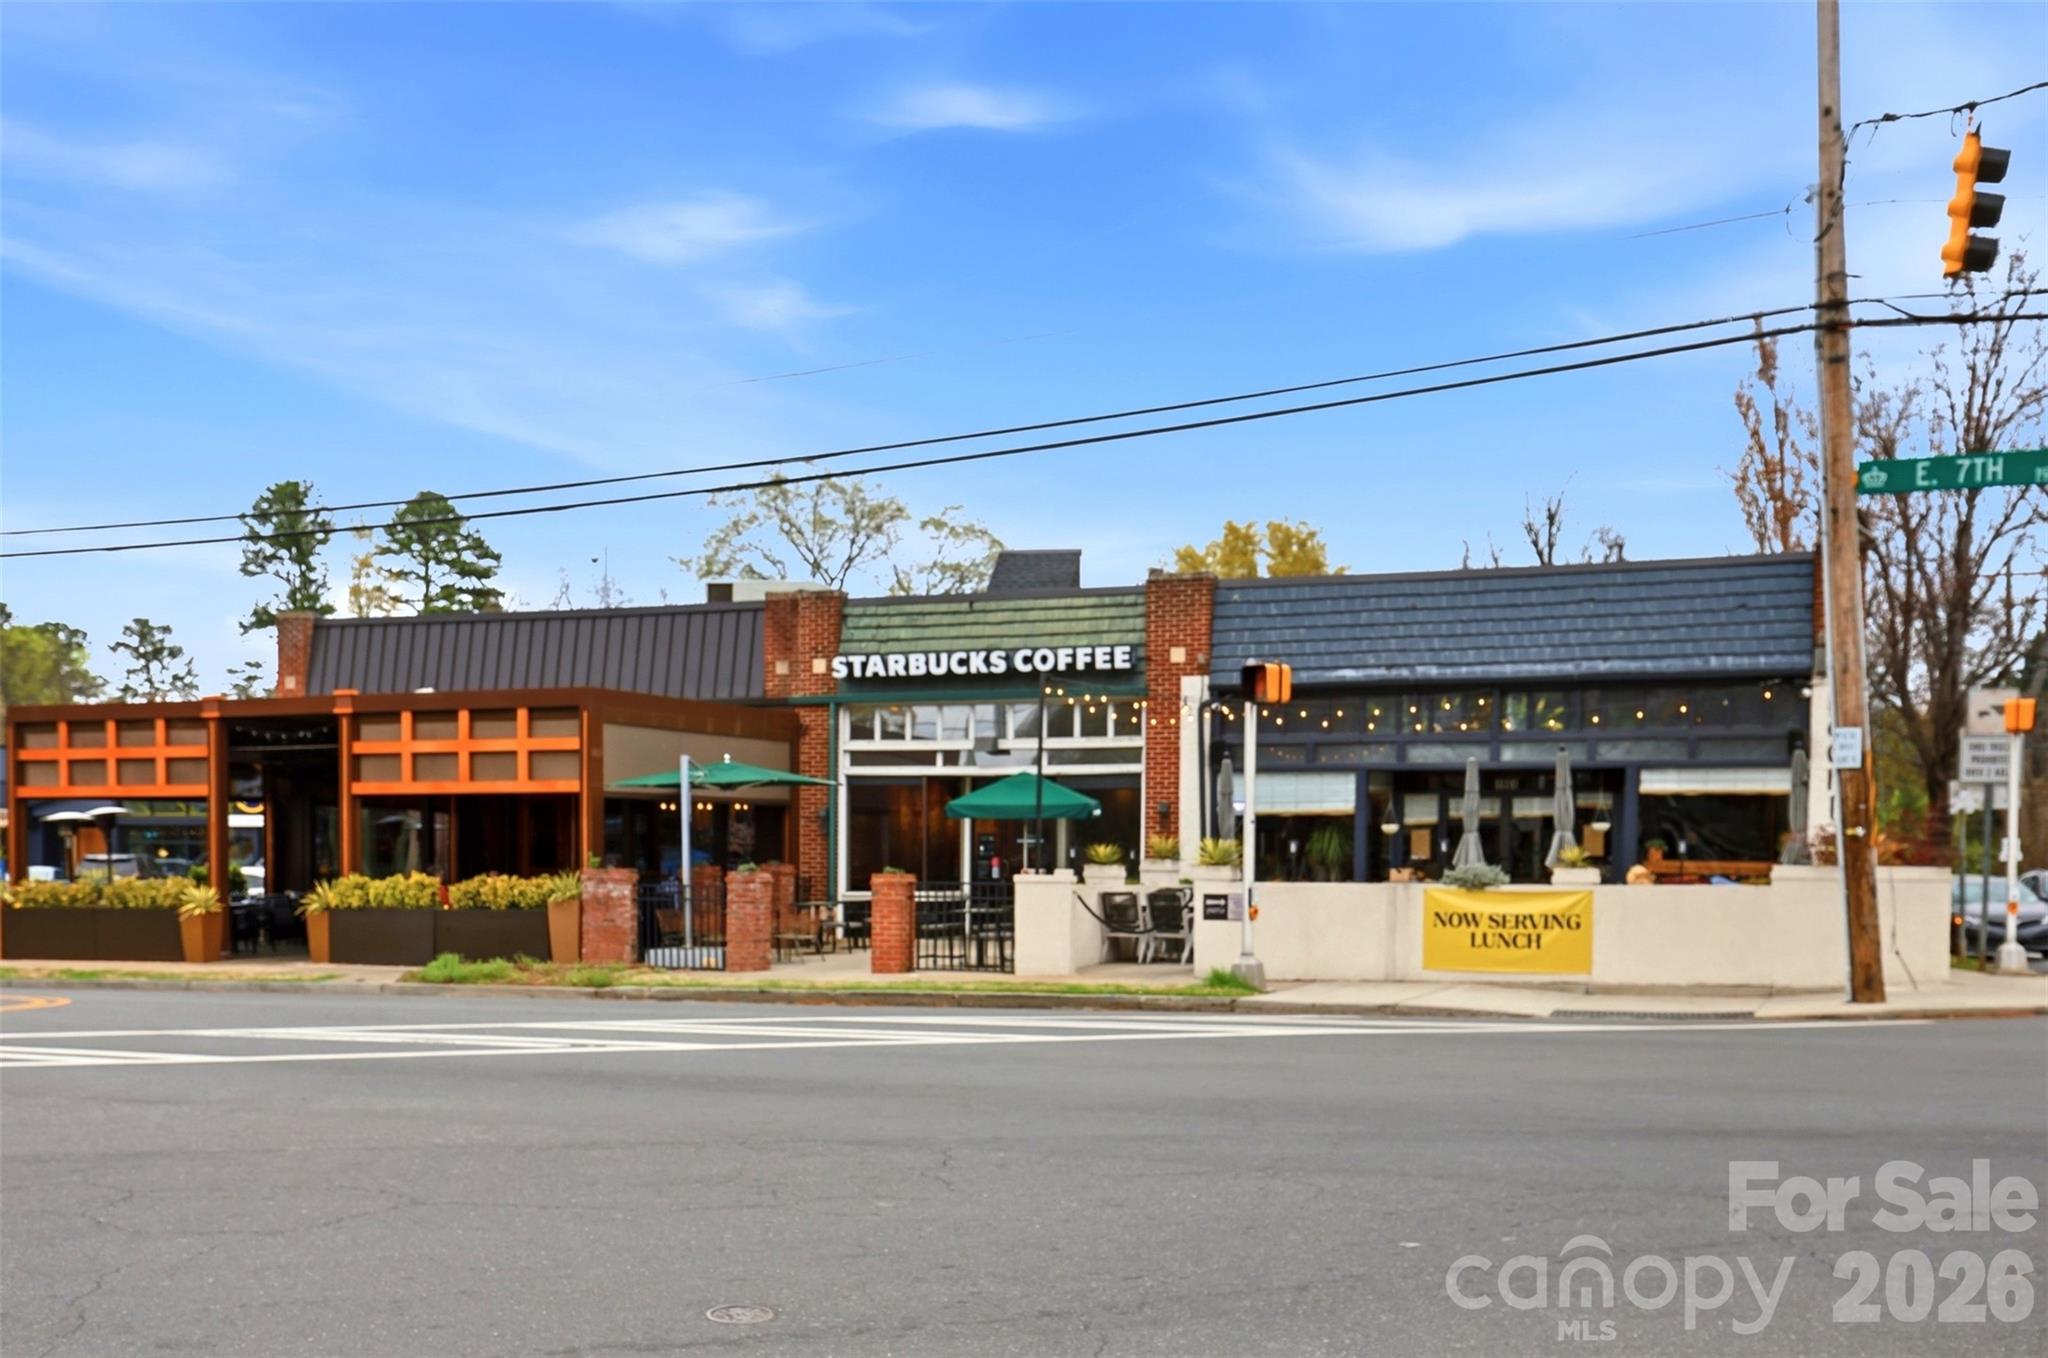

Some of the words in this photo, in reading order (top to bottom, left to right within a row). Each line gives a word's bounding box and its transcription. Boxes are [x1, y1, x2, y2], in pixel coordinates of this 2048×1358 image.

[1915, 461, 1938, 487] E.
[1956, 457, 2004, 483] 7TH
[832, 651, 1007, 678] STARBUCKS
[1013, 646, 1131, 673] COFFEE
[1434, 911, 1481, 928] NOW
[1488, 913, 1581, 931] SERVING
[1470, 932, 1542, 949] LUNCH
